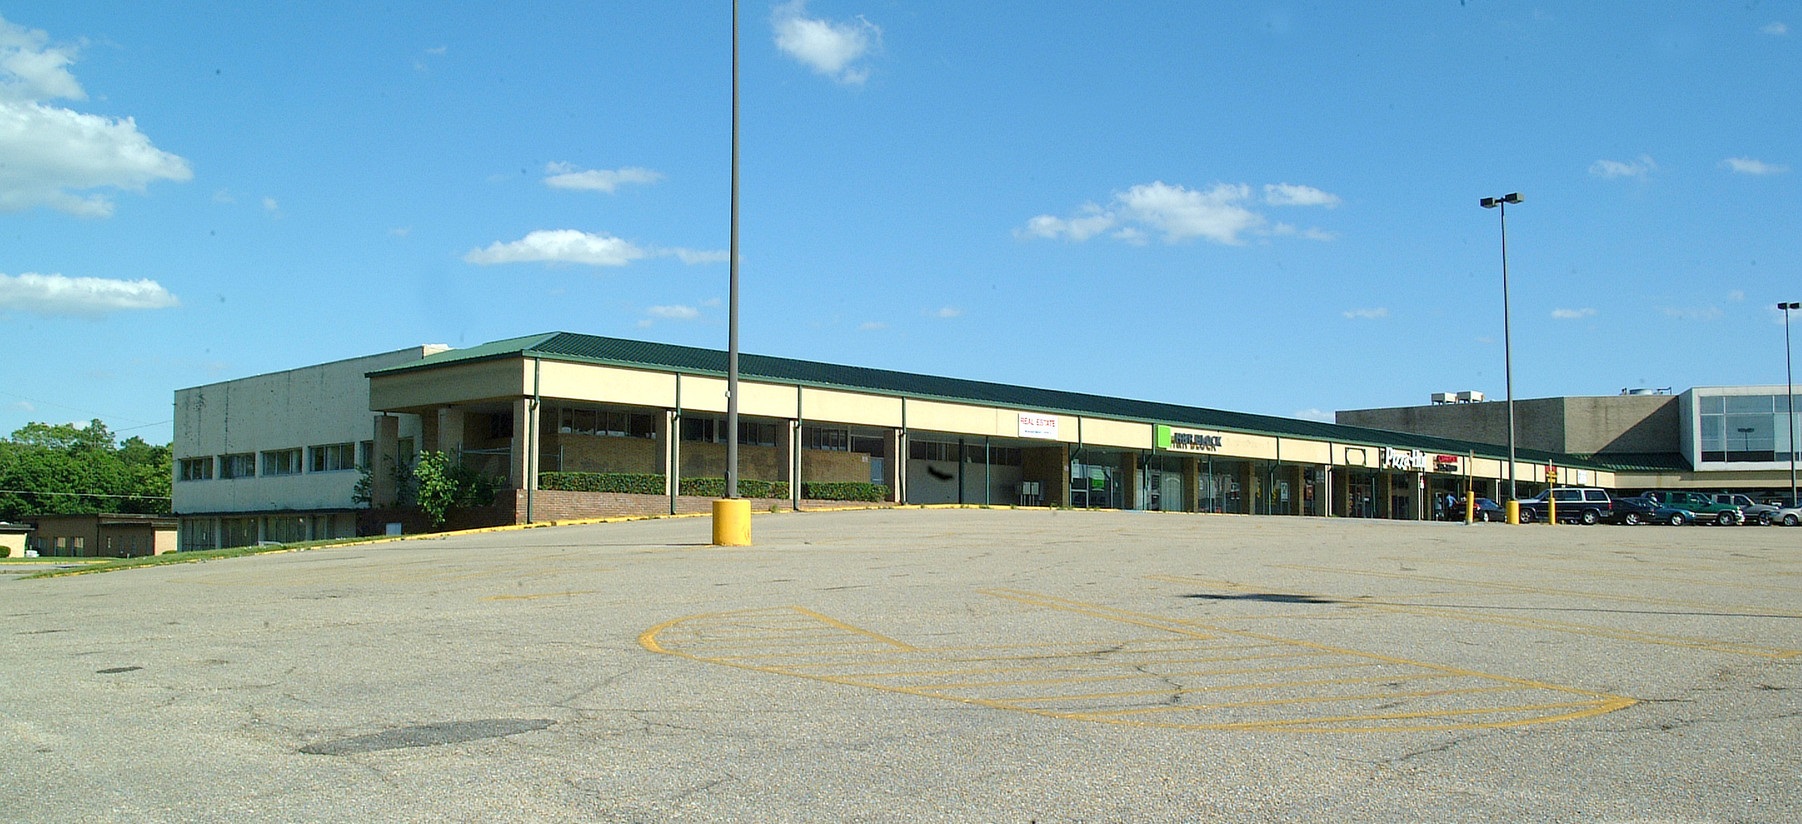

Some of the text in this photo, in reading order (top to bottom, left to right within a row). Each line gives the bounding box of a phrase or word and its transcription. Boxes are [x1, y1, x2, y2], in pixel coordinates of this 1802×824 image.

[1020, 417, 1056, 427] REAL ESTATE
[1194, 434, 1222, 448] BLOCK
[1385, 446, 1427, 470] Pizza Hut
